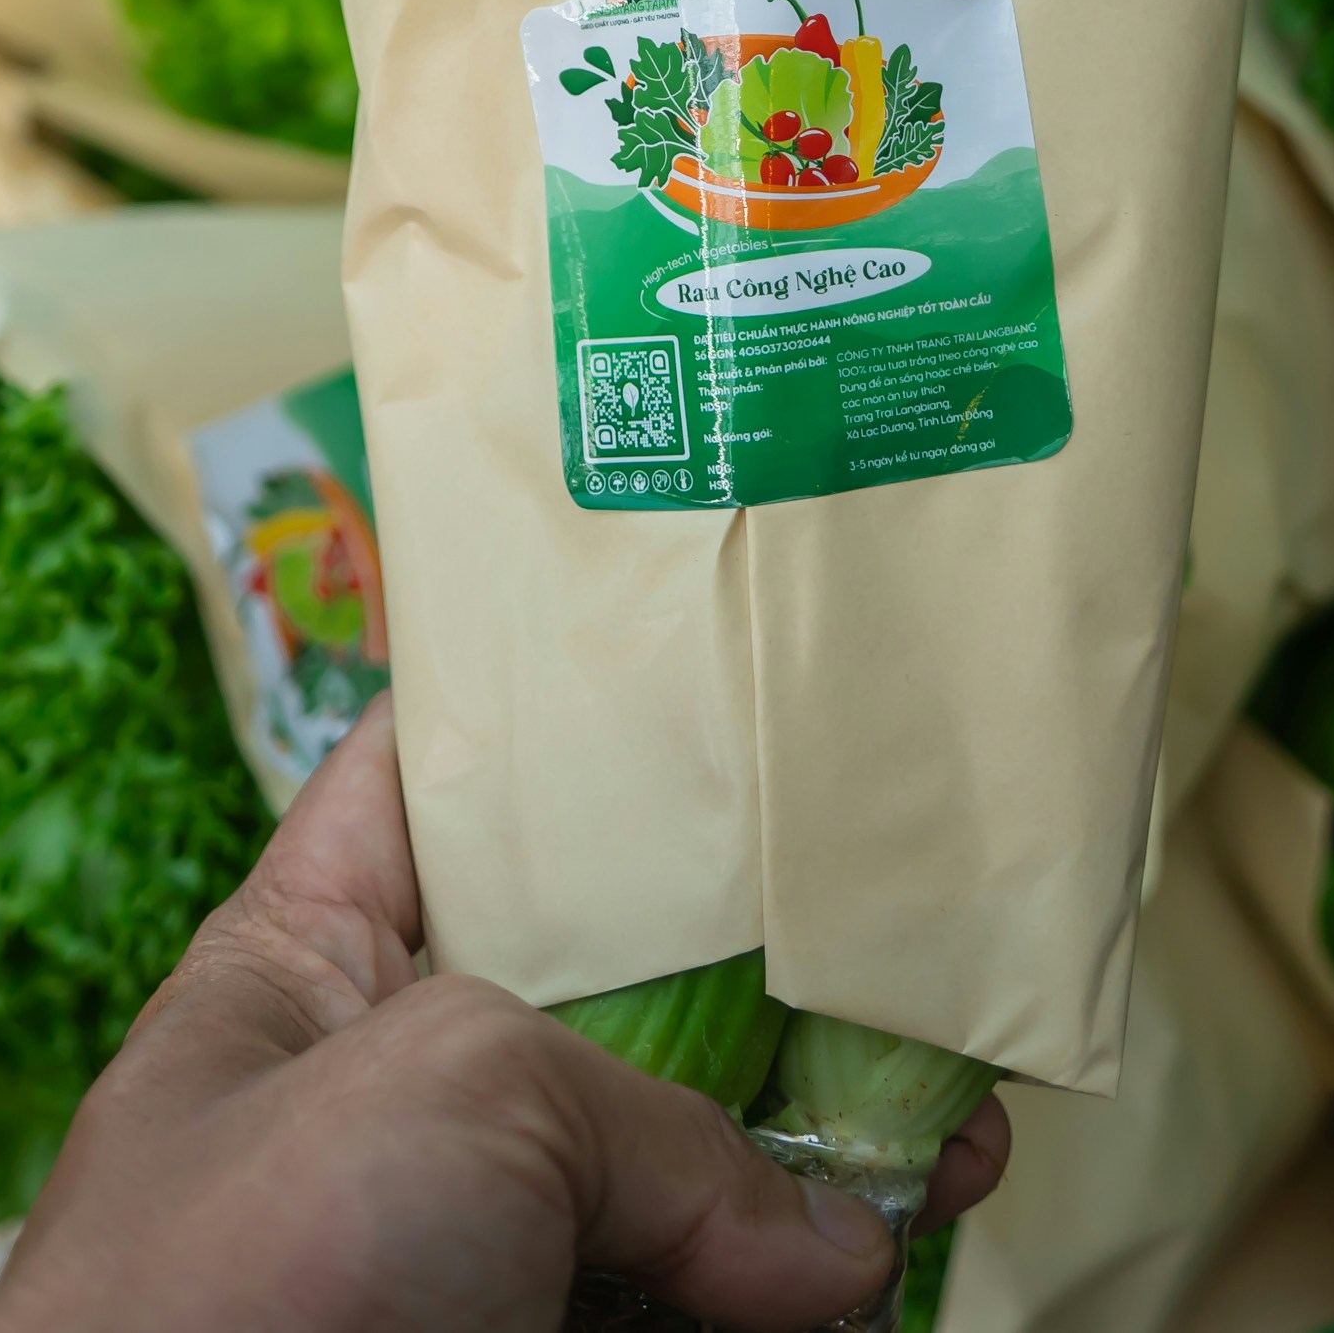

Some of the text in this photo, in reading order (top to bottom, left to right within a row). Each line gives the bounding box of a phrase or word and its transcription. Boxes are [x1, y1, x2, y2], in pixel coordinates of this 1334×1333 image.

[642, 240, 769, 289] High-tech Vegetables
[677, 260, 906, 304] Rau Công Nghệ Cao
[842, 311, 875, 326] NÔNG
[877, 305, 916, 321] NGHIỆP
[938, 297, 968, 311] TOÀN
[694, 349, 707, 361] Số
[738, 335, 831, 357] 4050373020644
[836, 348, 869, 364] CÔNG
[871, 346, 884, 359] TY
[886, 342, 914, 357] TNHH
[916, 335, 951, 350] TRANG
[976, 322, 1037, 341] LANGBIANG
[745, 367, 753, 377] &
[838, 366, 867, 379] 100%
[868, 362, 887, 374] rau
[938, 350, 962, 363] theo
[963, 347, 989, 360] công
[1018, 338, 1039, 351] cao
[842, 396, 861, 410] các
[844, 410, 874, 425] Trang
[752, 427, 773, 441] gói:
[849, 459, 867, 472] 3-5
[979, 438, 996, 452] gói
